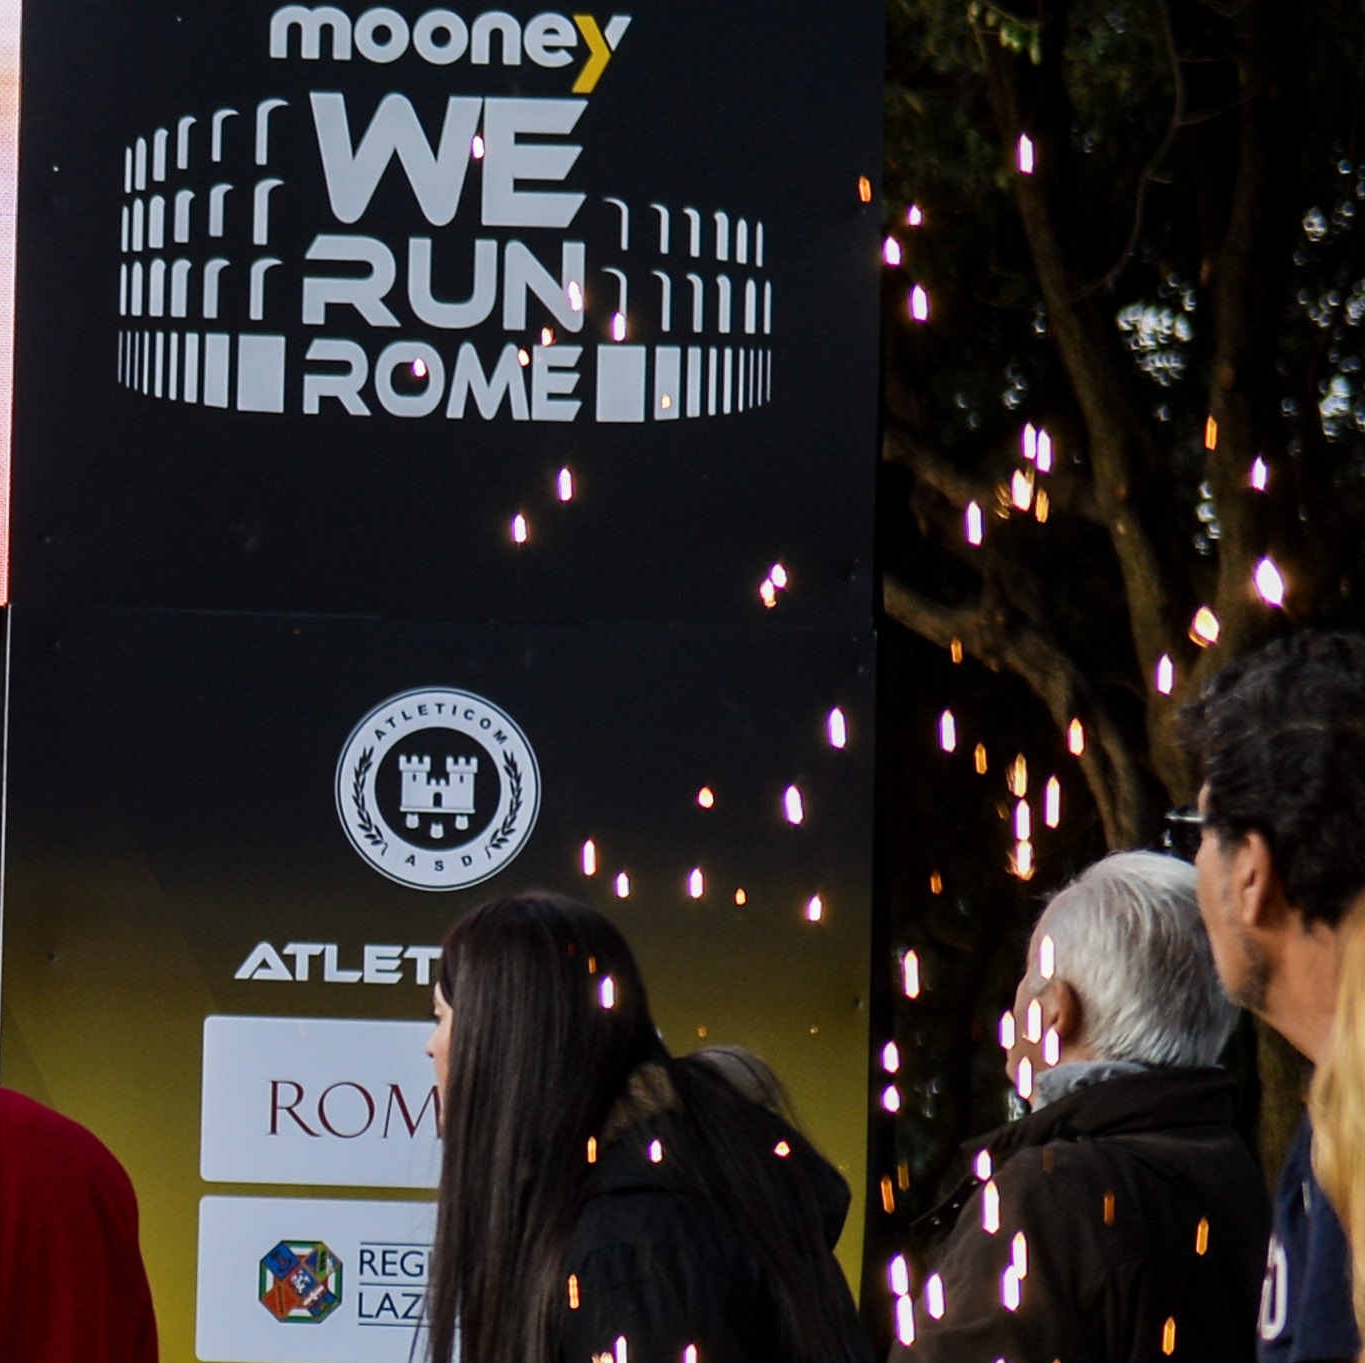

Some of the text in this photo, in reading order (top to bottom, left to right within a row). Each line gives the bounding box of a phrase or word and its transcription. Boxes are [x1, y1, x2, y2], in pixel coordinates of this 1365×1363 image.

[269, 6, 631, 93] mooney
[310, 91, 589, 228] WE
[302, 234, 586, 333] RUN
[302, 339, 582, 423] ROME
[373, 703, 508, 745] ATLETICOM
[234, 941, 443, 985] ATLET
[267, 1080, 443, 1140] ROM
[358, 1292, 423, 1320] LAZ
